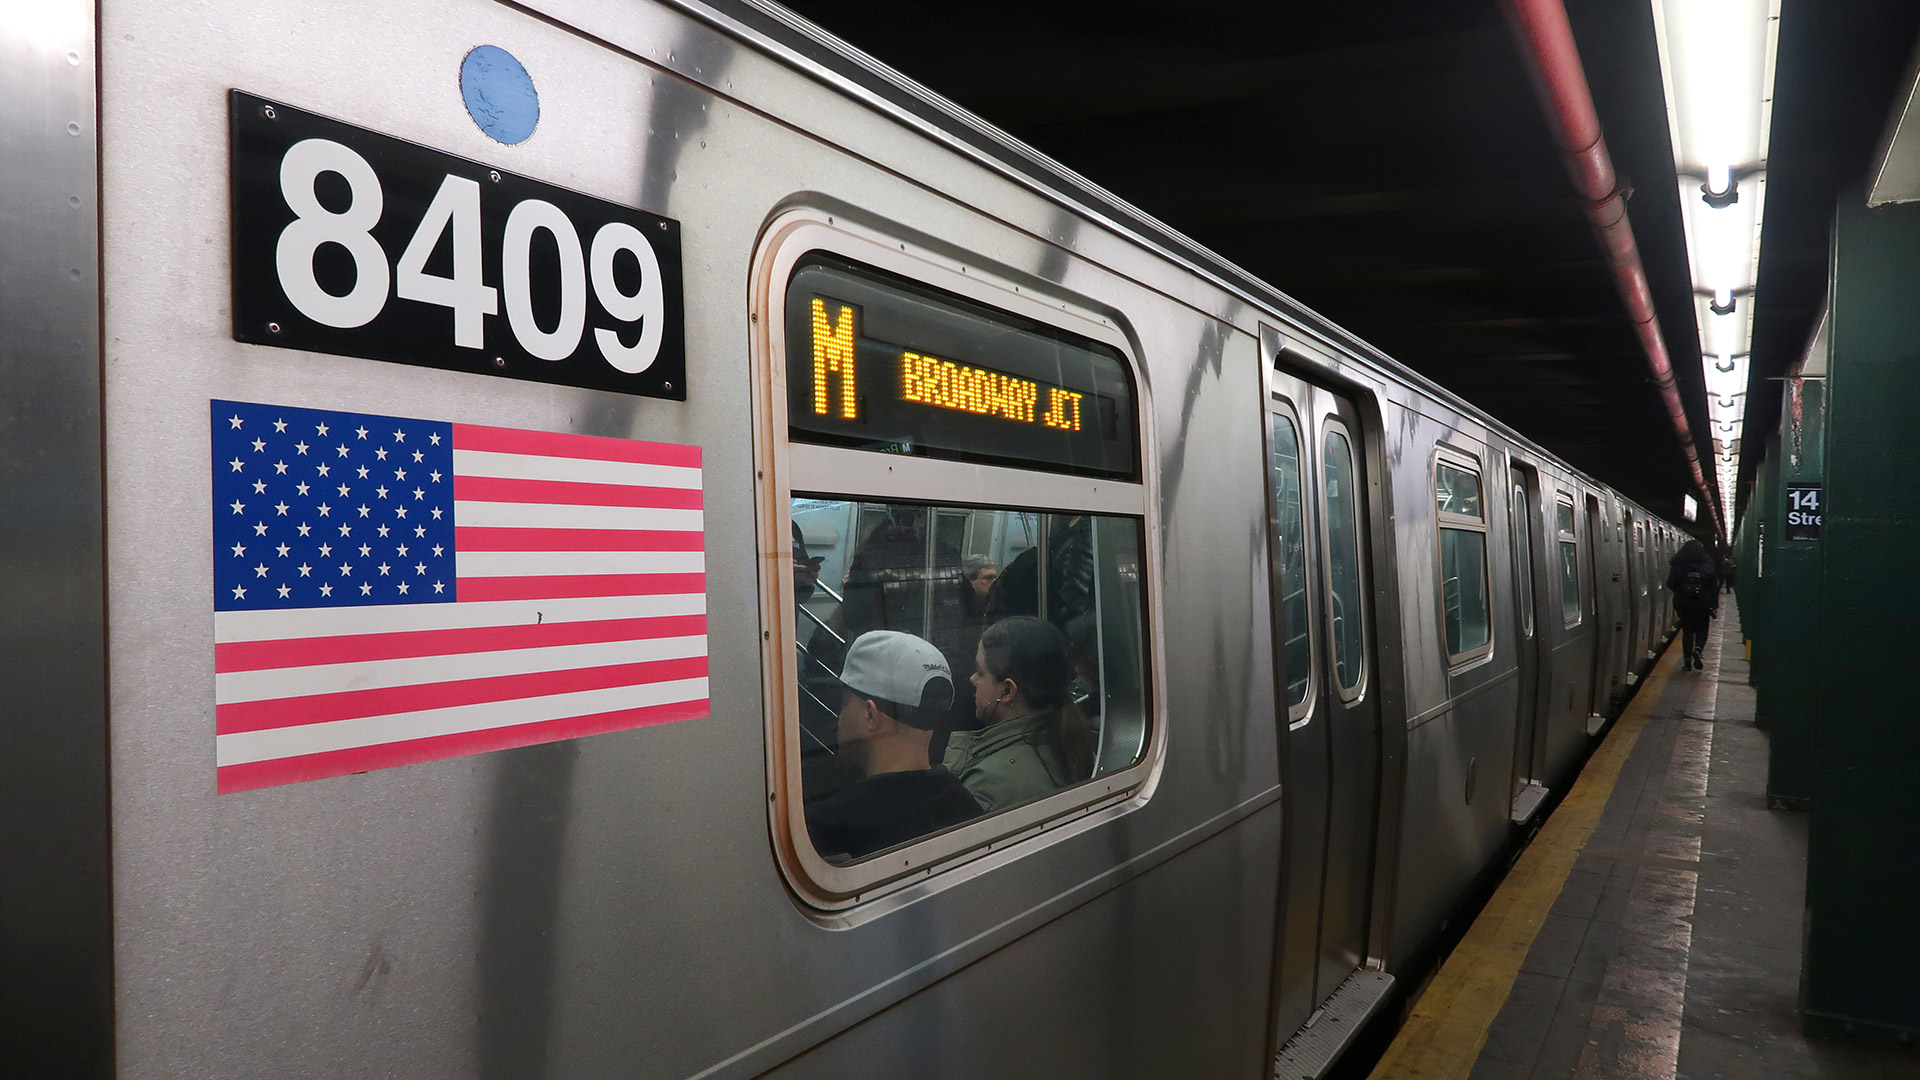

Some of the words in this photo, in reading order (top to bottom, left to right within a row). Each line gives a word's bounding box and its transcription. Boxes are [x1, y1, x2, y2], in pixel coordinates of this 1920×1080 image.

[276, 138, 664, 374] 8409
[811, 298, 857, 419] M
[904, 351, 1037, 423] BROADWAY
[1044, 387, 1083, 431] JCT
[1788, 490, 1820, 511] 14
[1788, 511, 1822, 526] Stre
